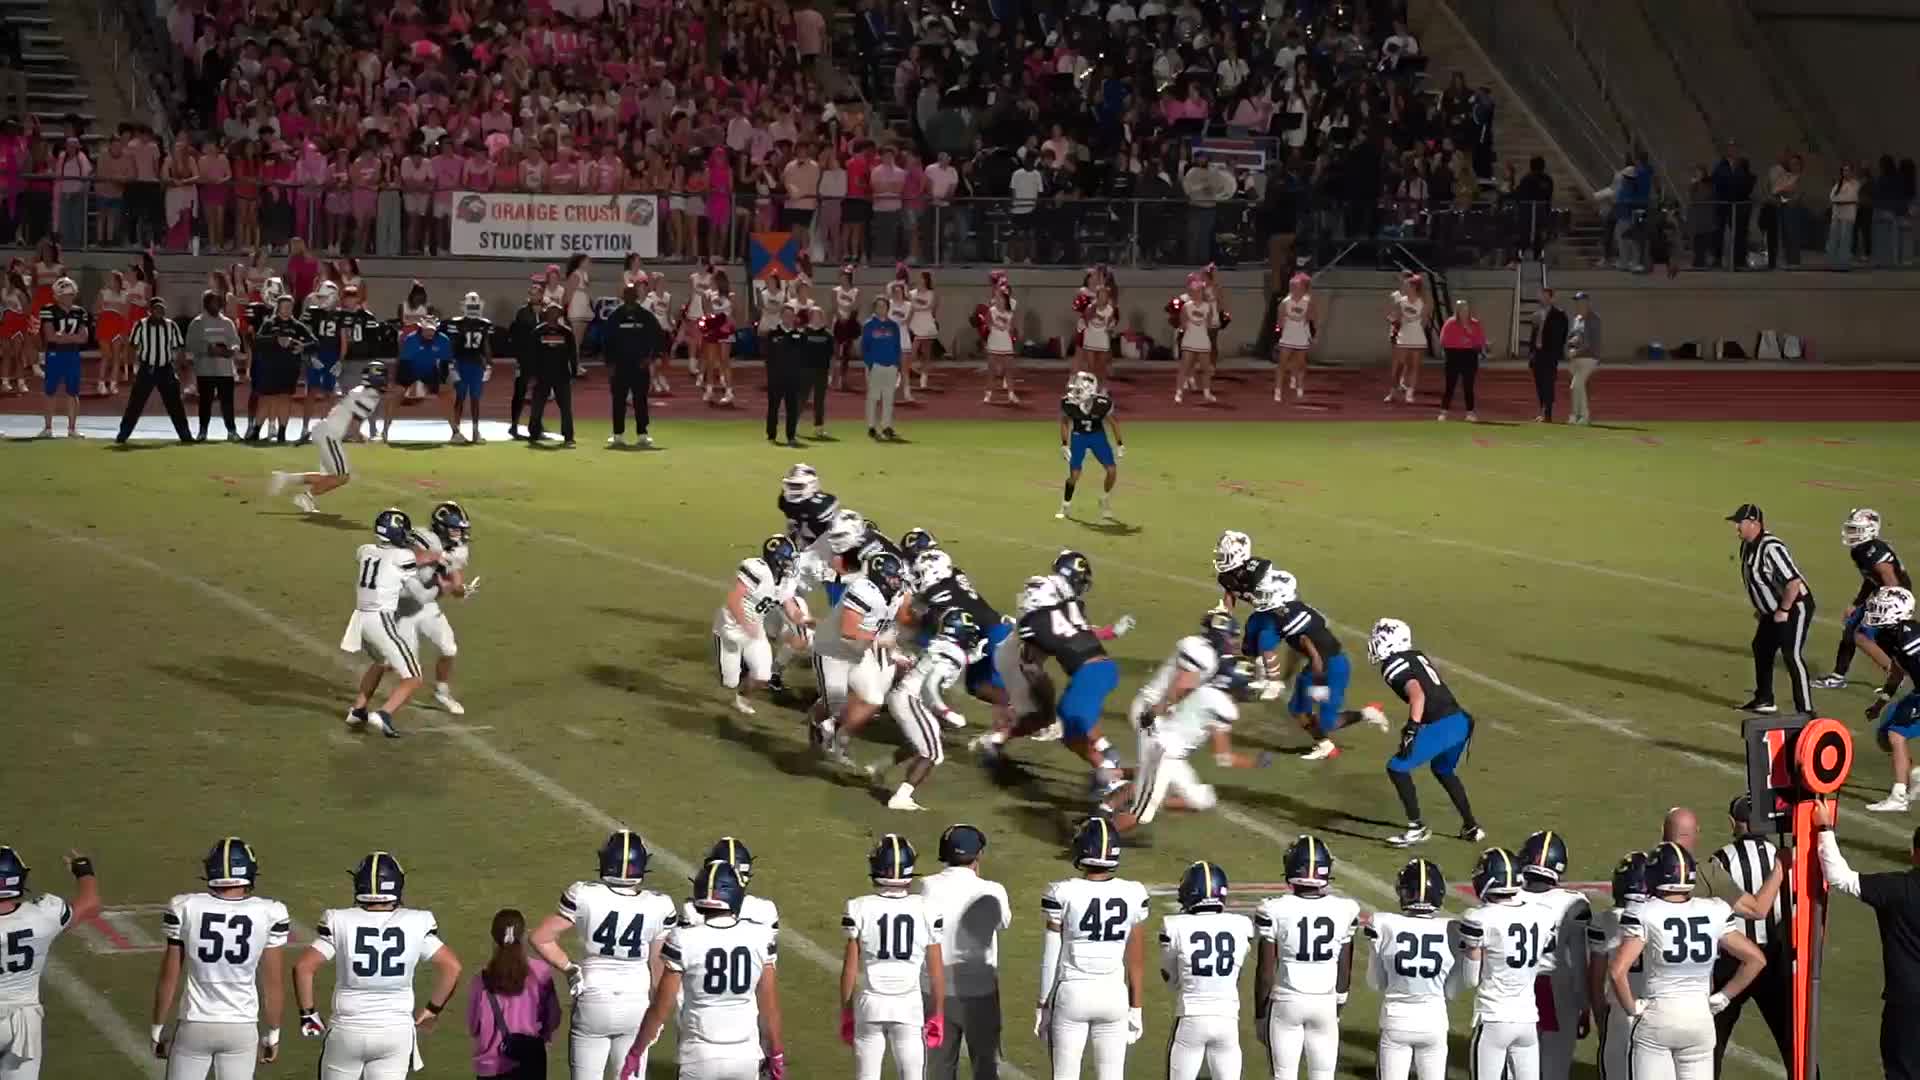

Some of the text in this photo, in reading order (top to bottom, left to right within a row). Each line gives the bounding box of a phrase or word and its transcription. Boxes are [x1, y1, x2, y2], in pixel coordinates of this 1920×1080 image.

[491, 203, 621, 222] ORANGE CRUSH
[479, 232, 632, 251] STUDENT SECTION
[56, 318, 78, 336] 17
[319, 320, 336, 337] 12
[464, 331, 482, 349] 13
[360, 557, 382, 590] 11
[198, 912, 254, 964] 53
[592, 911, 644, 957] 44
[877, 913, 915, 960] 10
[1079, 898, 1128, 941] 42
[1296, 916, 1335, 961] 12
[1663, 916, 1712, 963] 35
[0, 928, 34, 974] 5
[353, 926, 405, 977] 52
[1190, 931, 1235, 976] 28
[1395, 931, 1444, 978] 25
[1506, 922, 1539, 969] 31
[703, 946, 751, 994] 80
